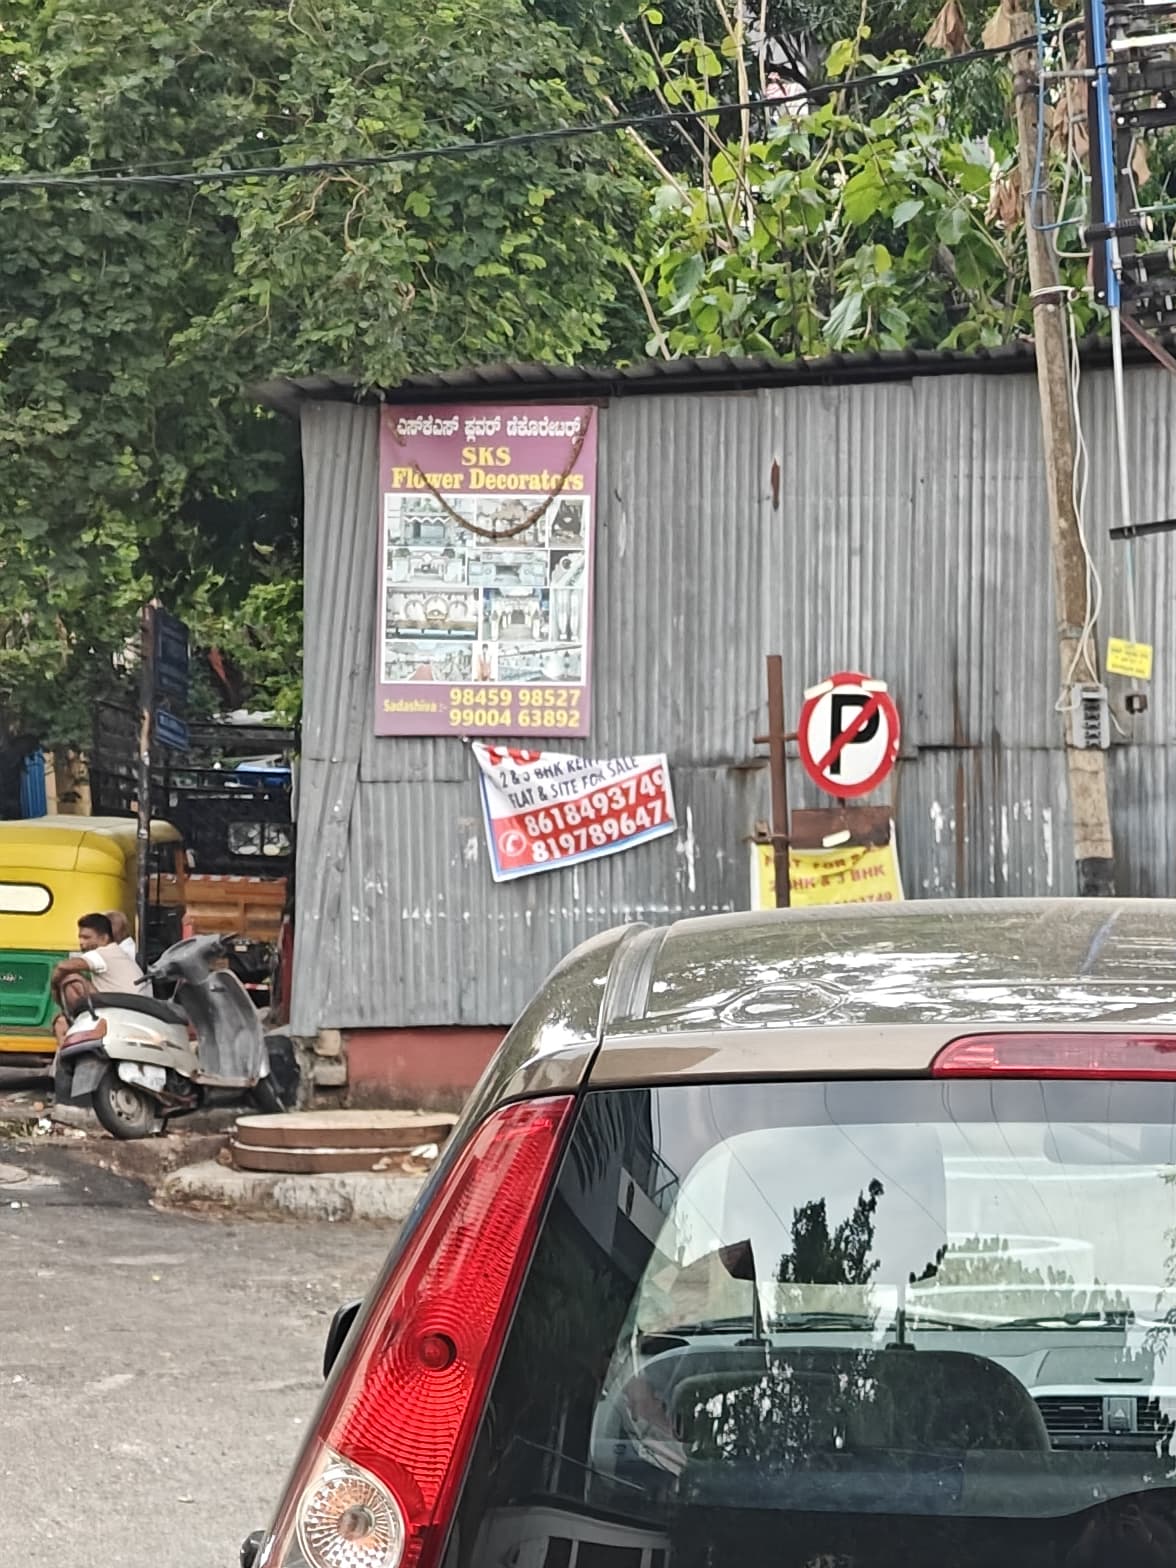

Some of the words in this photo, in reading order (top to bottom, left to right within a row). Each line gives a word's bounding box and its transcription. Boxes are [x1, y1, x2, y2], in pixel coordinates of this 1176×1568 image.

[461, 447, 511, 466] SKS
[391, 467, 464, 490] Flower
[469, 468, 584, 491] Decorators
[450, 688, 512, 706] 98459
[518, 689, 581, 707] 98527
[449, 709, 511, 727] 99004
[517, 710, 580, 728] 63892
[508, 790, 539, 809] FLAT
[551, 780, 579, 799] SITE
[606, 757, 639, 778] SALE
[531, 792, 672, 863] 819789647
